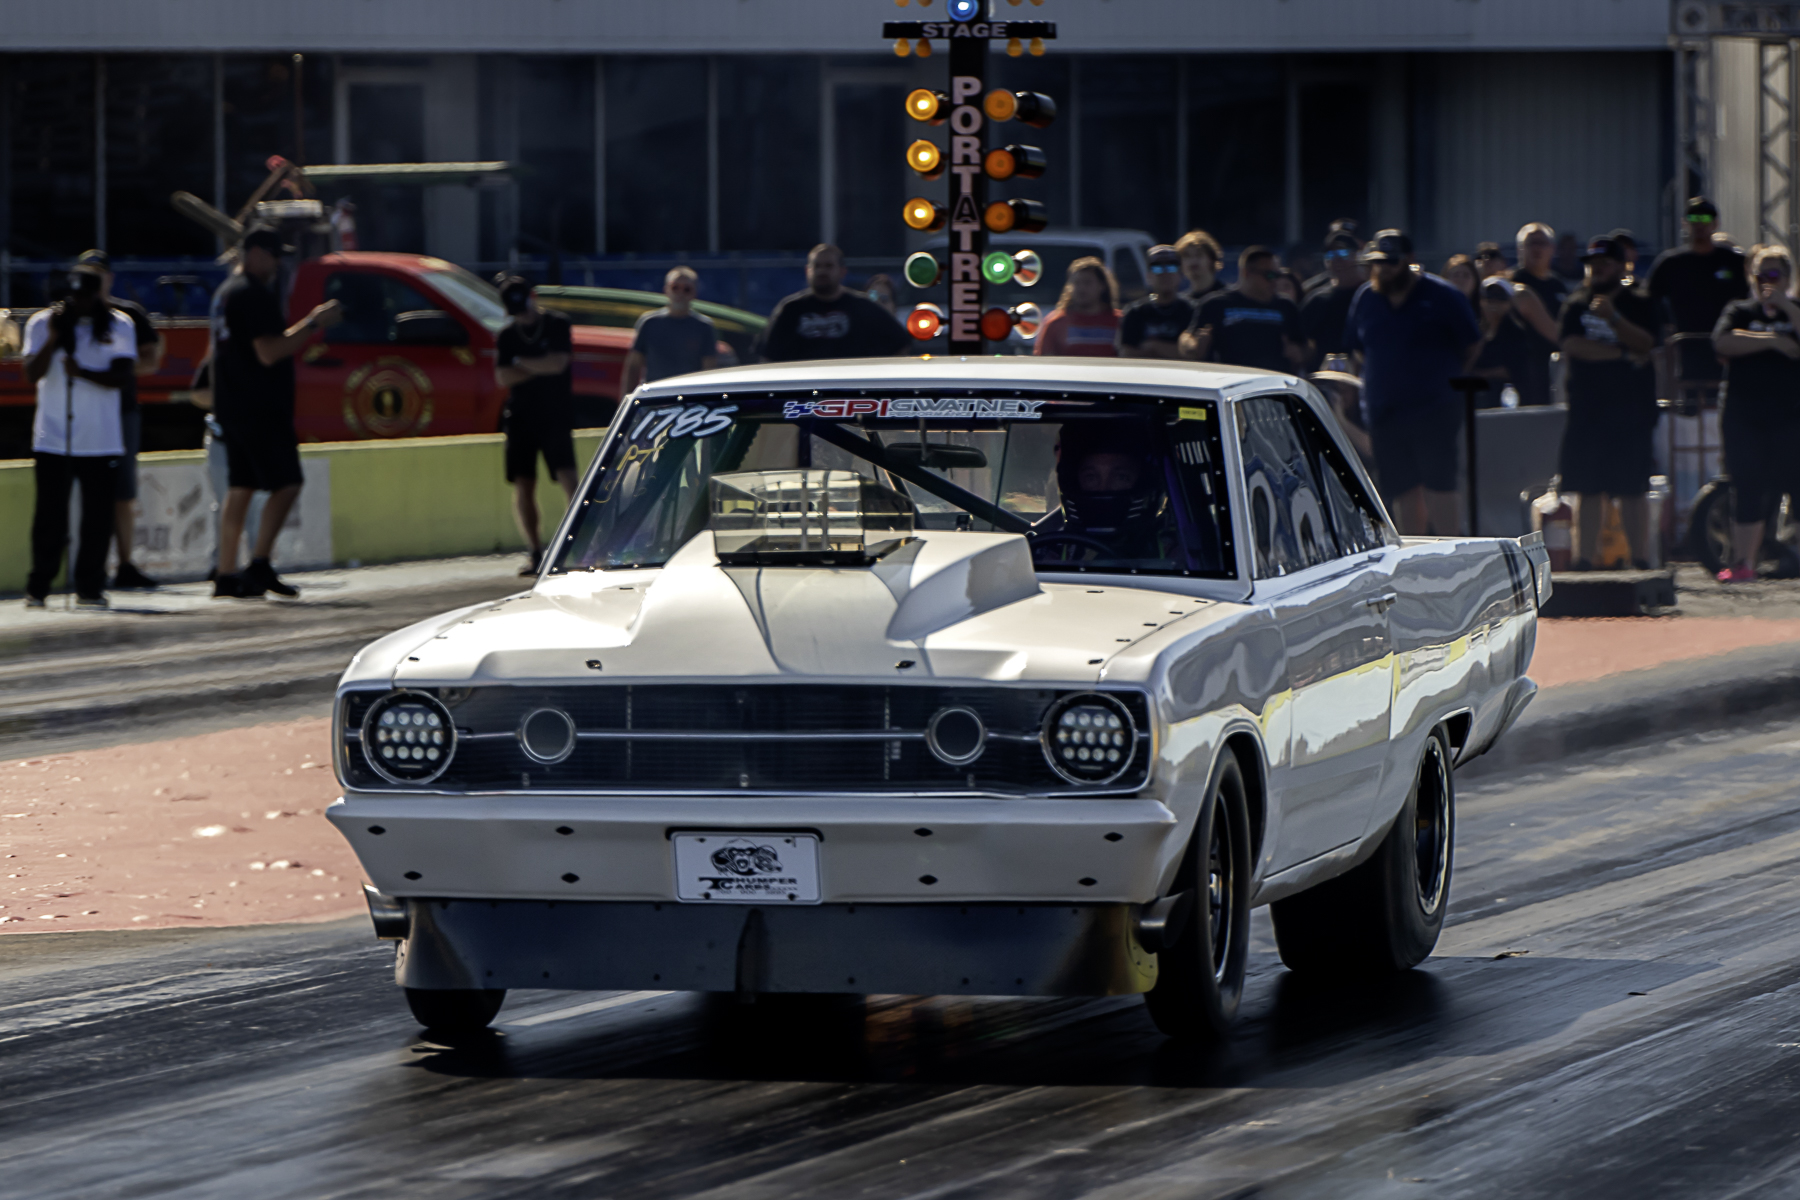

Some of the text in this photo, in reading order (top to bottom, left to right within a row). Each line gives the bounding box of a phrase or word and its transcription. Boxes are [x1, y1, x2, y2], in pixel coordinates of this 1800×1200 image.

[922, 23, 1008, 38] STAGE
[951, 75, 983, 342] PORTATREE
[630, 404, 739, 440] 1785
[814, 399, 1046, 418] GPI GWATNEY
